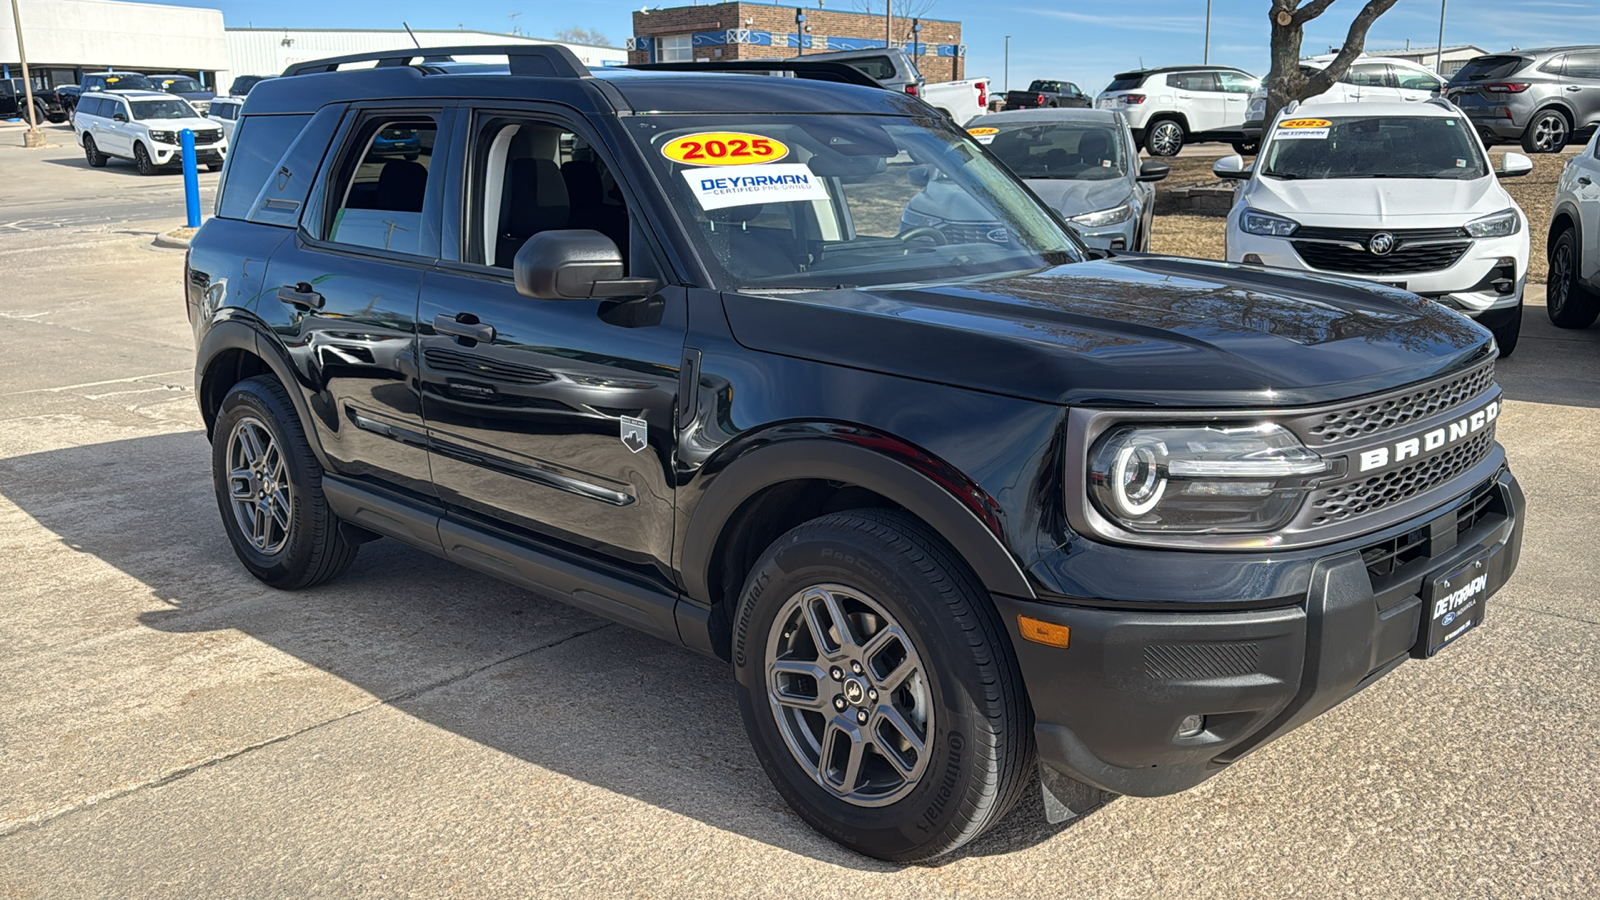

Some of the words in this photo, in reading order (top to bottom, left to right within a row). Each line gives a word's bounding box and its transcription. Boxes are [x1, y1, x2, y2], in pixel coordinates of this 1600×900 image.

[680, 139, 774, 160] 2025
[701, 174, 809, 191] DEYARMAN
[713, 186, 760, 195] CERTIFIED
[762, 184, 812, 192] PRE-OWNED
[1360, 401, 1498, 472] BRONCO
[1433, 573, 1488, 620] DEYARMAN
[735, 577, 765, 668] Continental
[922, 730, 967, 834] Continental
